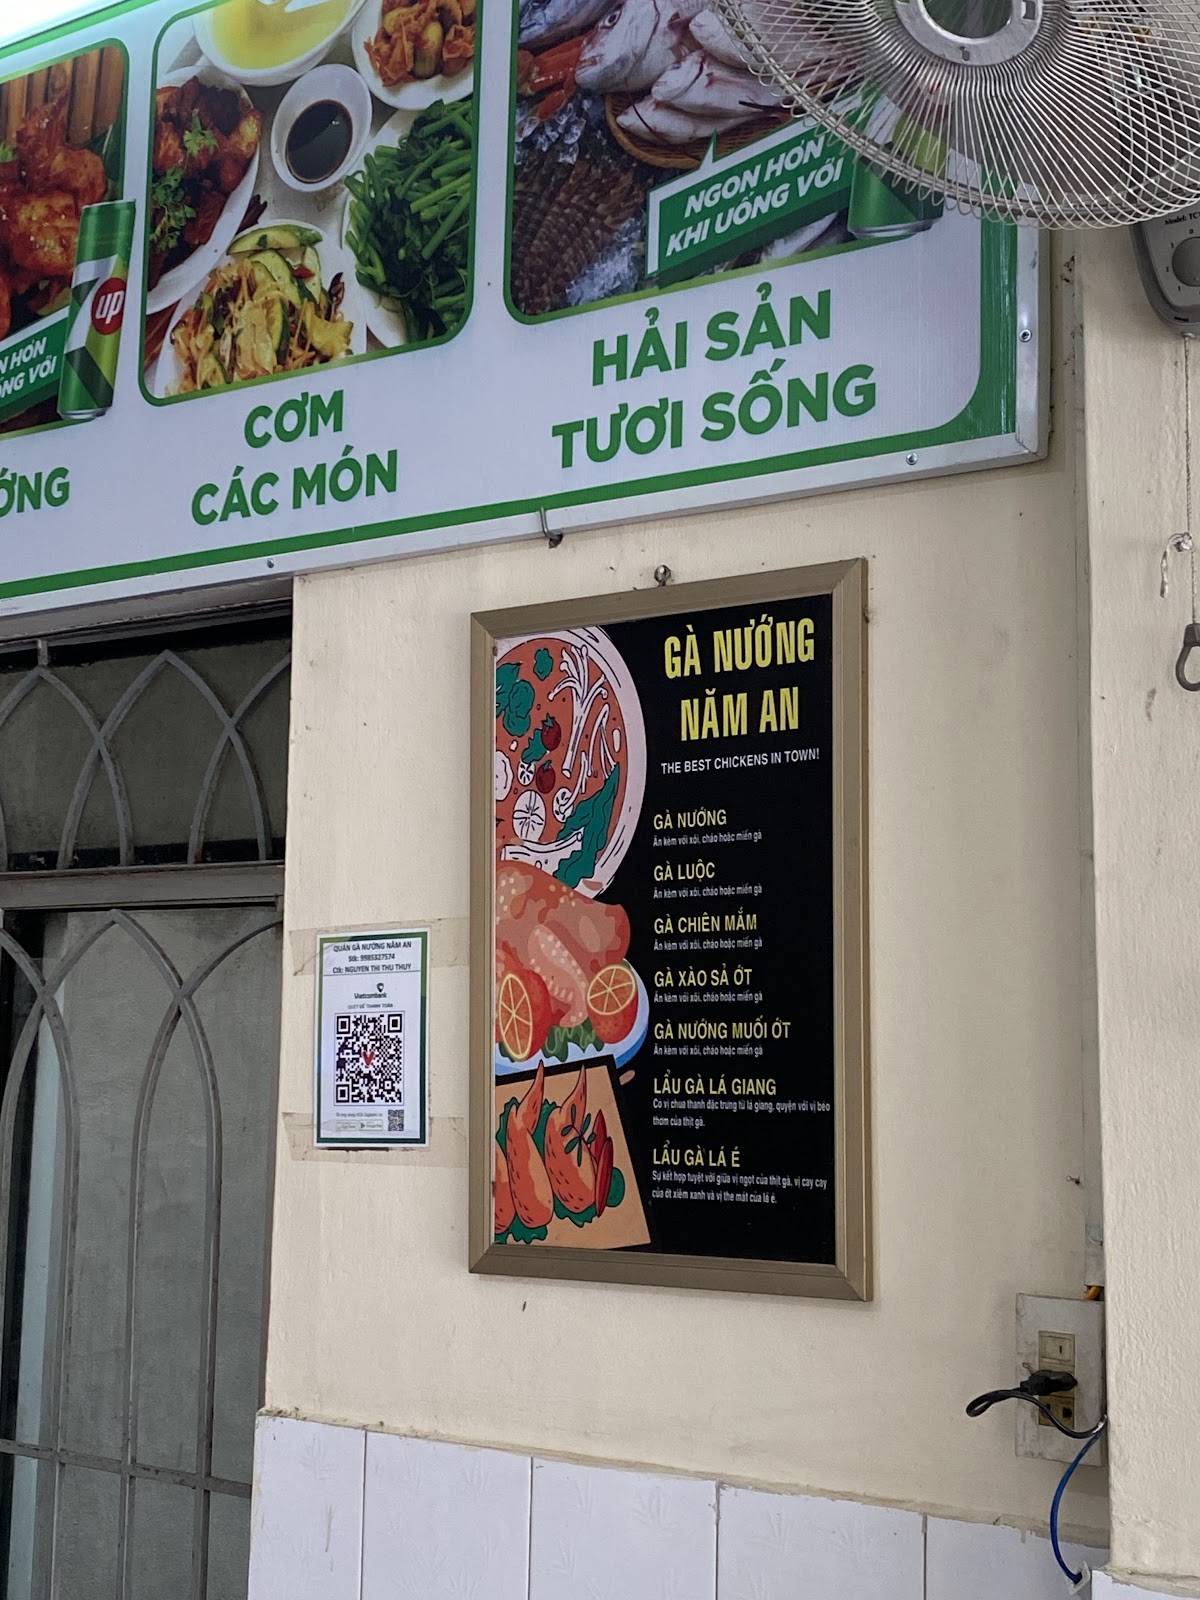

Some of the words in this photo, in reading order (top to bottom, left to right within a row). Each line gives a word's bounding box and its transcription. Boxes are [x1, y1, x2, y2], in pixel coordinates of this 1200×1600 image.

[684, 164, 761, 218] NGON
[764, 135, 825, 182] HƠN
[666, 218, 711, 257] KHI
[715, 182, 790, 234] UỐNG
[797, 156, 844, 198] VỚI
[592, 307, 688, 386] HẢI
[704, 281, 831, 361] SẢN
[9, 336, 47, 370] HƠN
[29, 354, 57, 384] VỚI
[244, 389, 344, 448] CƠM
[552, 397, 683, 469] TƯƠI
[700, 357, 876, 442] SỐNG
[191, 465, 279, 526] CÁC
[292, 444, 397, 510] MÓN
[664, 624, 702, 679] GÀ
[713, 613, 815, 673] NƯỚNG
[680, 687, 748, 741] NĂM
[759, 686, 799, 733] AN
[661, 761, 682, 774] THE
[684, 758, 712, 773] BEST
[714, 752, 769, 770] CHICKENS
[770, 752, 782, 764] IN
[784, 747, 820, 763] TOWN!
[654, 809, 673, 830] GÀ
[677, 806, 727, 828] NƯỚNG
[654, 860, 674, 881] GÀ
[677, 858, 715, 882] LUỘC
[654, 914, 674, 934] GÀ
[678, 912, 720, 932] CHIÊN
[724, 906, 757, 931] MẮM
[654, 967, 674, 987] GÀ
[678, 966, 707, 987] XÀO
[710, 962, 729, 986] SẢ
[733, 964, 752, 985] ỚT
[654, 1019, 674, 1039] GÀ
[678, 1018, 728, 1039] NƯỚNG
[732, 1014, 767, 1039] MUỐI
[771, 1017, 791, 1039] ỚT
[653, 1069, 681, 1094] LẨU
[685, 1073, 705, 1095] GÀ
[709, 1073, 727, 1095] LÁ
[731, 1078, 776, 1095] GIANG
[652, 1139, 680, 1165] LẨU
[684, 1144, 704, 1165] GÀ
[708, 1146, 727, 1167] LÁ
[731, 1146, 740, 1168] É
